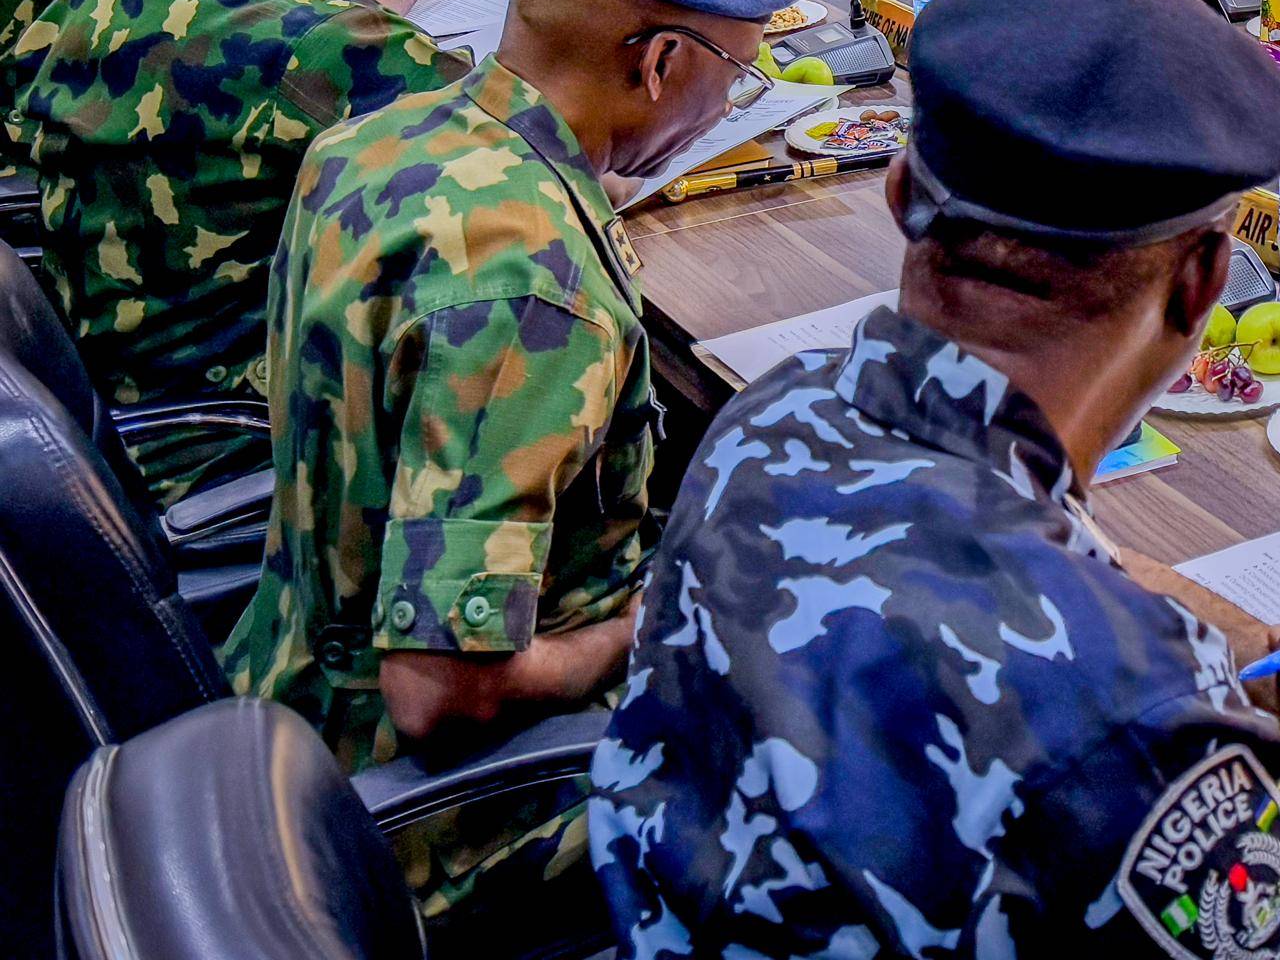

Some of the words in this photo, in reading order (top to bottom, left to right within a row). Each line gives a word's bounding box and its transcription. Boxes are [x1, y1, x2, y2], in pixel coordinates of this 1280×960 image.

[881, 18, 896, 40] OF
[1236, 207, 1273, 246] AIR
[1136, 761, 1254, 886] NIGERIA
[1162, 791, 1253, 893] POLICE
